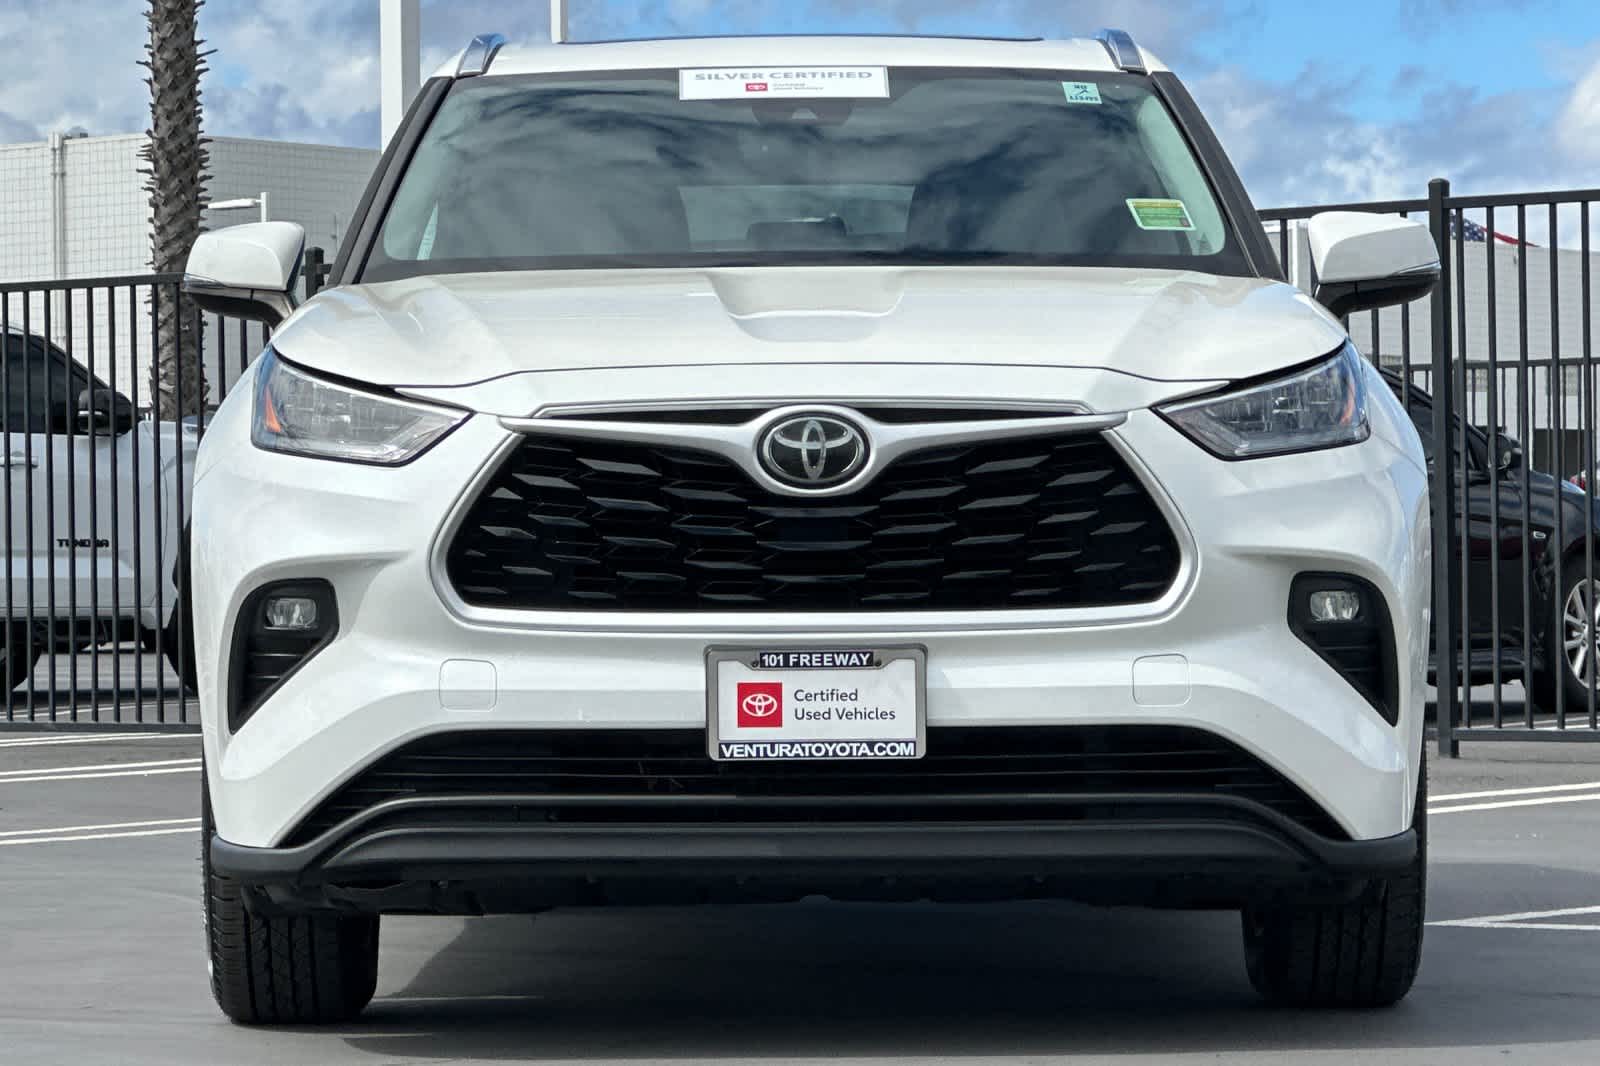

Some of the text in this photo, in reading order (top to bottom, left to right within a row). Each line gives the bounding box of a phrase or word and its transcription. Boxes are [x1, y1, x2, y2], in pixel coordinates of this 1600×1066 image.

[695, 71, 873, 80] SILVER CERTIFIED
[762, 653, 870, 667] 101 FREEWAY
[794, 688, 858, 702] Certified
[794, 707, 896, 721] Used Vehicles
[721, 742, 915, 758] VENTURATOYOTA.COM
